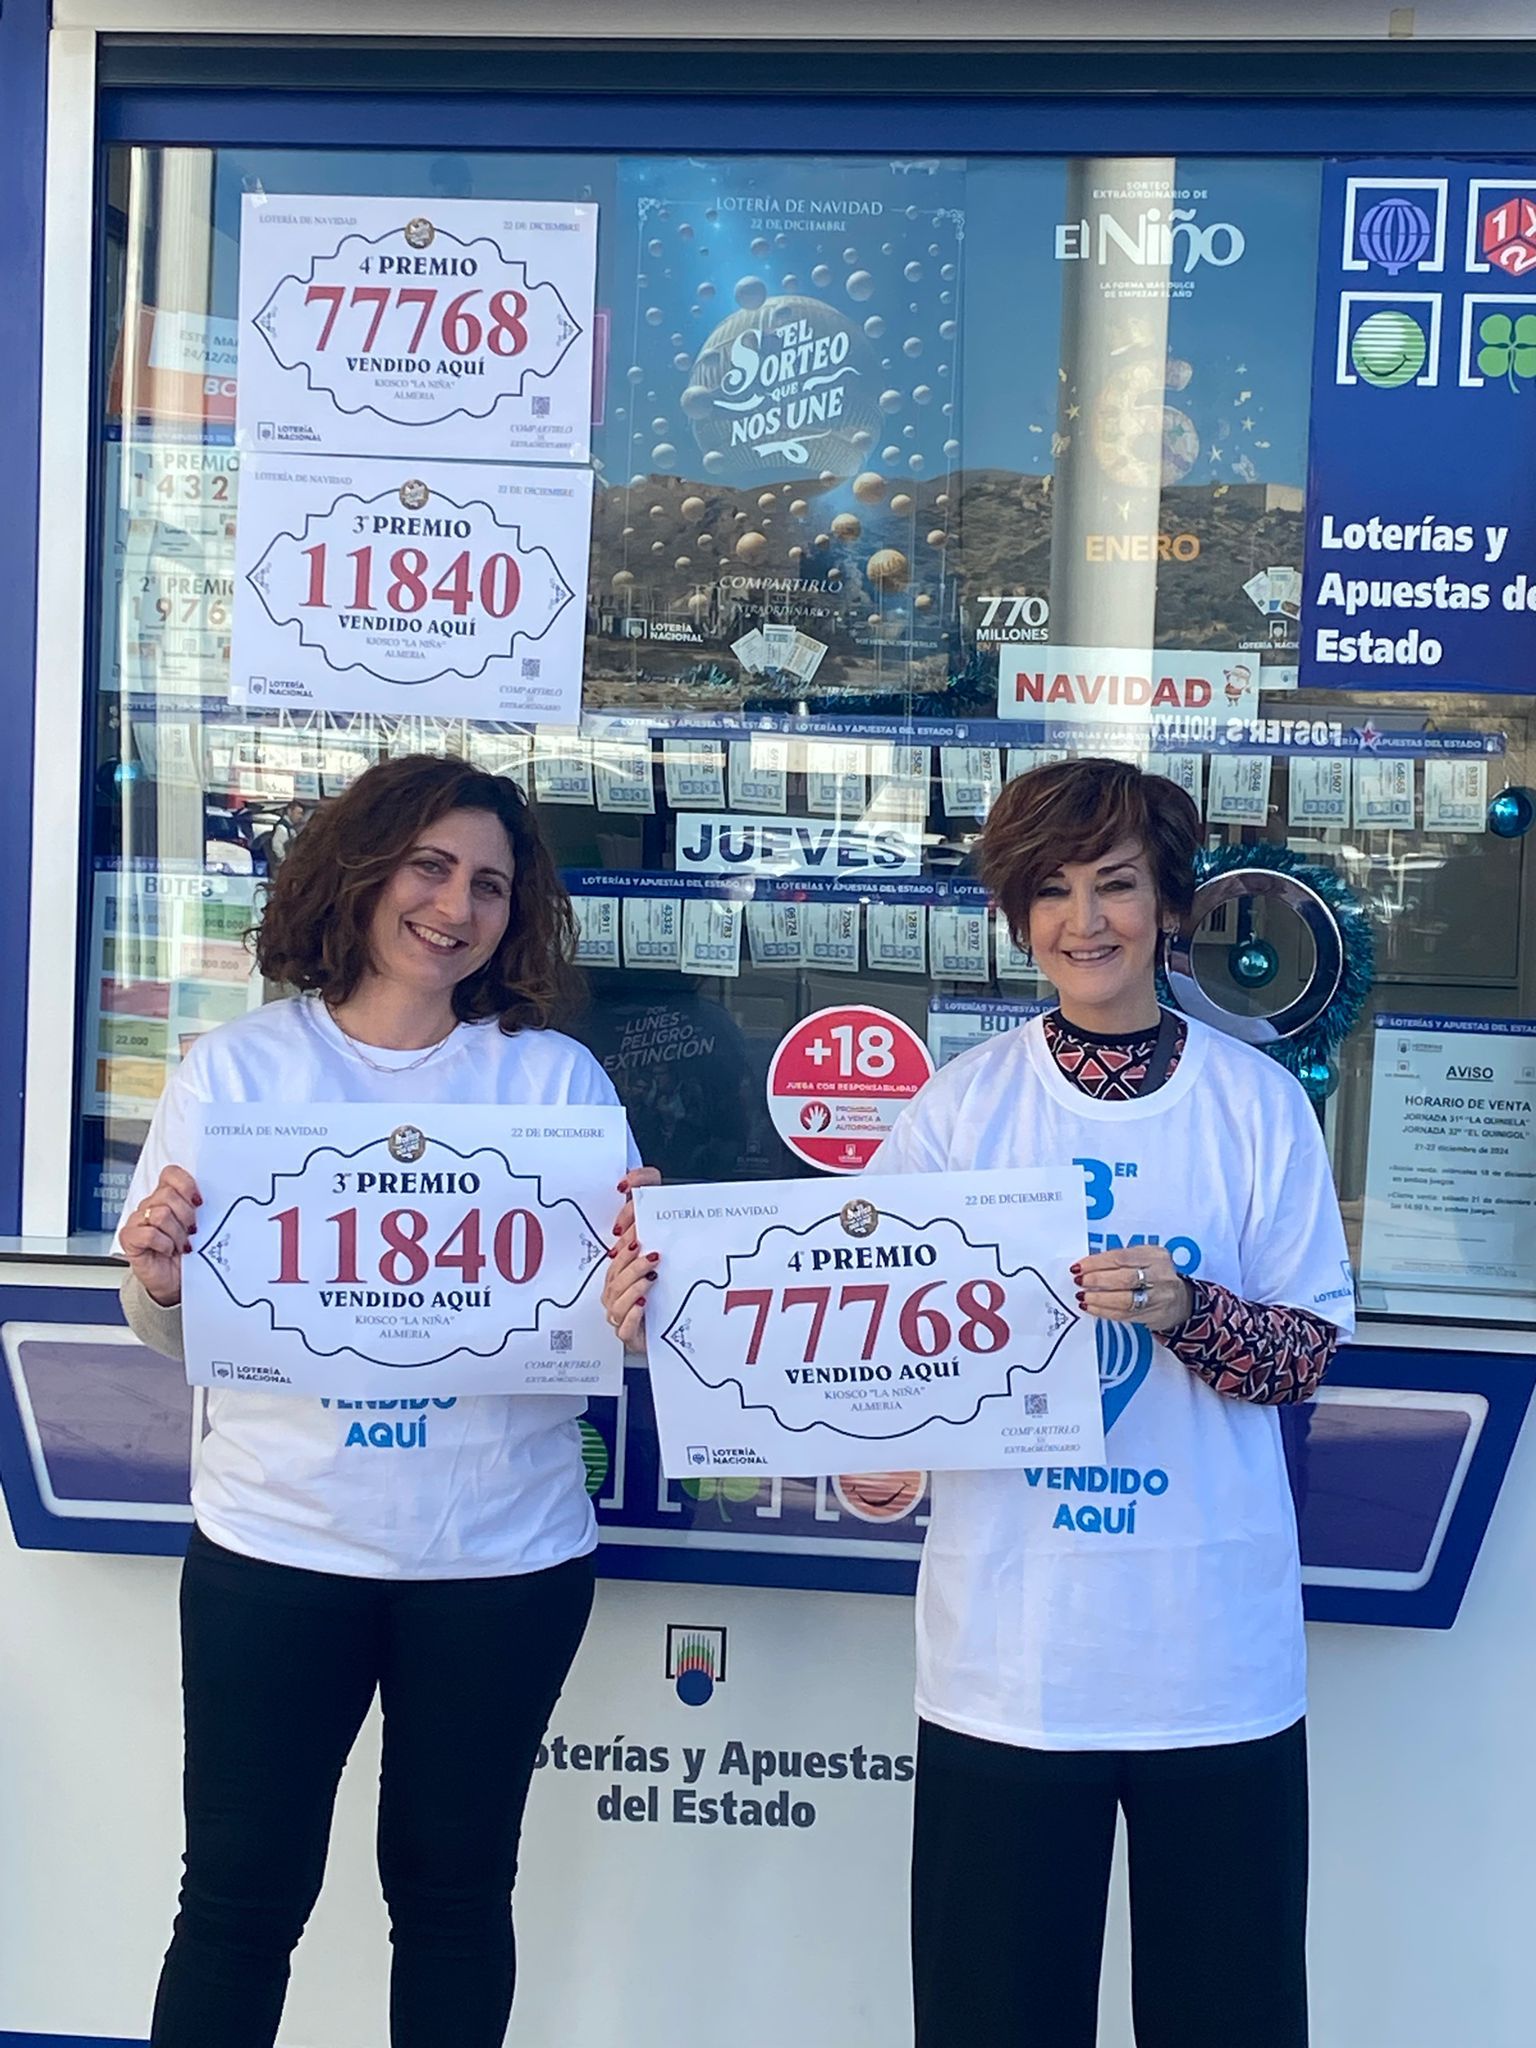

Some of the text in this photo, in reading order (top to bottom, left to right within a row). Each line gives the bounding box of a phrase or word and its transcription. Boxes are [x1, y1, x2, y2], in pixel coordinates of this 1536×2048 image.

[1093, 190, 1208, 199] EXTRAORDINARIO DE
[1126, 182, 1170, 190] SORTEO
[716, 195, 883, 216] LOTERÍA DE NAVIDAD
[750, 219, 847, 232] 22 DE DICIEMBRE
[1098, 207, 1245, 273] Niño
[379, 257, 478, 276] PREMIO
[304, 286, 528, 356] 77768
[776, 319, 814, 349] EL
[346, 357, 485, 377] VENDIDO AQUÍ
[720, 329, 849, 396] SORTEO
[731, 386, 845, 447] NOS UNE
[277, 424, 312, 434] LOTERÍA
[277, 432, 321, 442] NACIONAL
[373, 516, 471, 538] PREMIO
[1086, 533, 1200, 562] ENERO
[1321, 515, 1508, 562] Loterías y
[299, 542, 520, 619] 11840
[720, 575, 843, 594] COMPARTIRLO
[1317, 573, 1490, 615] Apuestas
[977, 596, 1049, 626] 770
[338, 615, 476, 636] VENDIDO AQUÍ
[650, 622, 693, 633] LOTERÍA
[976, 628, 1049, 641] MILLONES
[650, 632, 704, 643] NACIONAL
[1316, 629, 1442, 665] Estado
[269, 680, 304, 690] LOTERÍA
[269, 688, 313, 698] NACIONAL
[1016, 672, 1212, 708] NAVIDAD
[796, 722, 842, 732] LOTERÍAS
[851, 725, 897, 734] APUESTAS
[918, 727, 953, 735] ESTADO
[1424, 738, 1442, 748] DEL
[1444, 738, 1481, 748] ESTADO
[682, 822, 907, 869] JUEVES
[582, 876, 631, 886] LOTERÍAS
[638, 878, 684, 887] APUESTAS
[776, 881, 824, 890] LOTERÍAS
[833, 883, 877, 892] APUESTAS
[899, 885, 934, 894] ESTADO
[625, 1012, 680, 1035] LUNES
[1390, 1017, 1507, 1032] LOTERÍAS APUESTAS DEL
[620, 1025, 693, 1051] PELIGRO
[603, 1036, 715, 1072] EXTINCIÓN
[805, 1025, 895, 1078] +18
[1446, 1066, 1494, 1080] AVISO
[787, 1082, 917, 1093] JUEGA CON RESPONSABILIDAD
[1405, 1095, 1532, 1112] HORARIO DE VENTA
[204, 1124, 328, 1137] LOTERÍA DE NAVIDAD
[512, 1128, 605, 1138] 22 DE DICIEMBRE
[357, 1172, 481, 1195] PREMIO
[965, 1190, 1063, 1206] 22 DE DICIEMBRE
[656, 1204, 779, 1222] LOTERÍA DE NAVIDAD
[267, 1206, 544, 1286] 11840
[812, 1244, 938, 1271] PREMIO
[319, 1286, 492, 1311] VENDIDO AQUÍ
[355, 1315, 398, 1326] KIOSCO
[723, 1279, 1010, 1365] 77768
[237, 1366, 280, 1376] LOTERÍA
[237, 1373, 292, 1384] NACIONAL
[785, 1358, 960, 1385] VENDIDO AQUÍ
[824, 1389, 866, 1401] KIOSCO
[344, 1414, 428, 1449] AQUÍ
[712, 1447, 756, 1458] LOTERÍA
[712, 1454, 768, 1465] NACIONAL
[1024, 1466, 1169, 1497] VENDIDO
[1052, 1501, 1137, 1535] AQUÍ
[535, 1734, 915, 1786] oterías y Apuestas
[597, 1785, 817, 1827] del Estado
